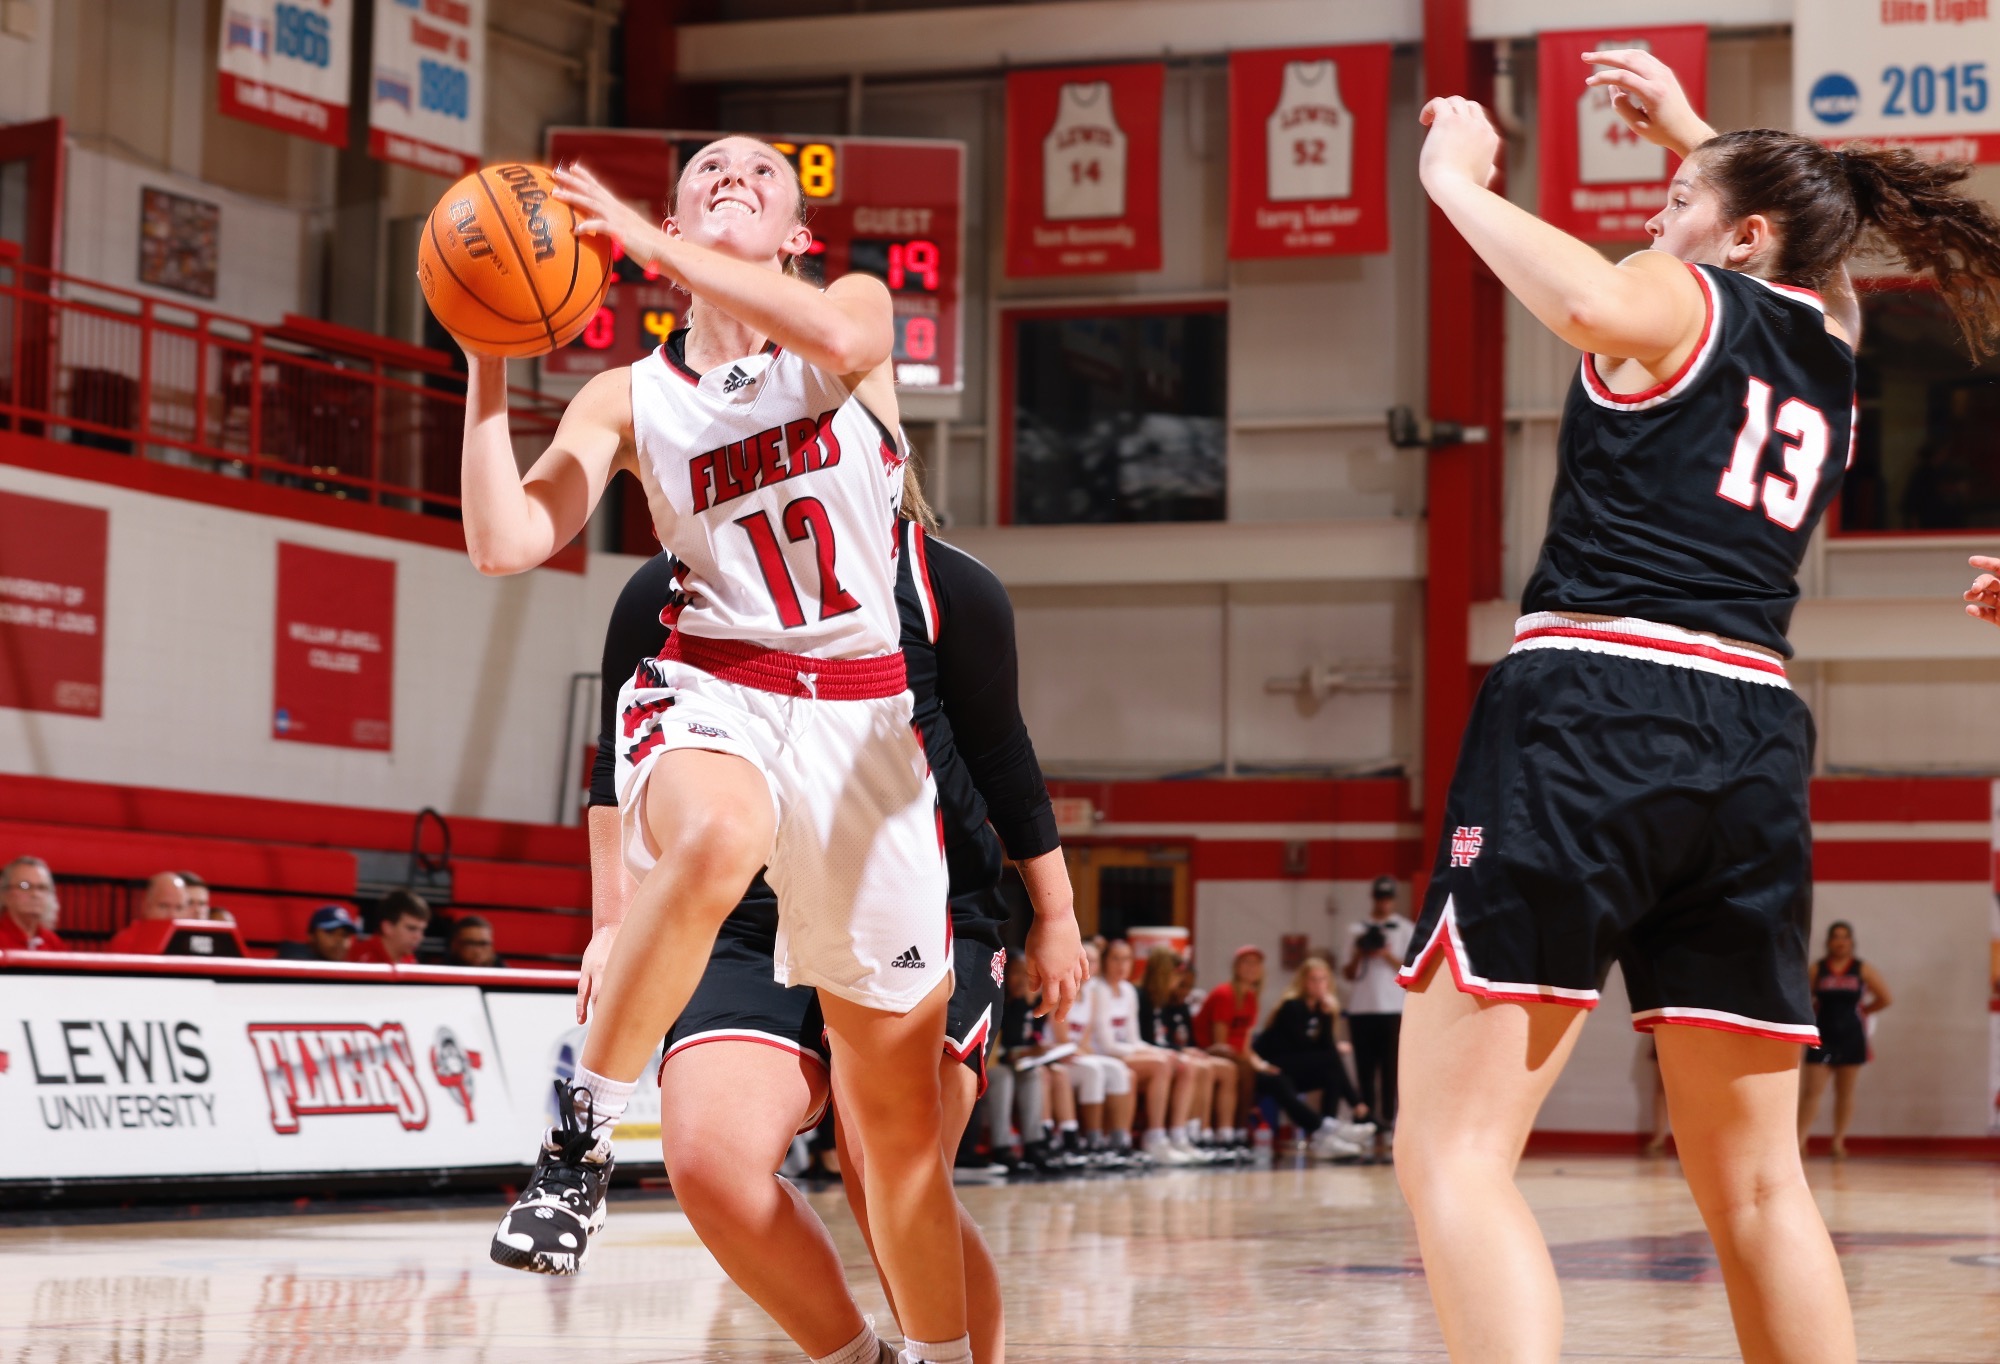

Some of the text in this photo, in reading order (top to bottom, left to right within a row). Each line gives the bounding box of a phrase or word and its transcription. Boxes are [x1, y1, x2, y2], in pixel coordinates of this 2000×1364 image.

[1881, 63, 1988, 117] 2015
[1070, 159, 1102, 185] 14
[1293, 139, 1326, 166] 52
[853, 207, 933, 233] GUEST
[887, 240, 940, 290] 19
[723, 376, 757, 395] adidas
[689, 408, 842, 516] FLYERS
[1716, 375, 1830, 532] 13
[733, 495, 862, 631] 12
[890, 958, 926, 970] adidas
[20, 1019, 210, 1085] LEWIS
[248, 1022, 429, 1135] FLYERS
[38, 1092, 215, 1131] UNIVERSITY
